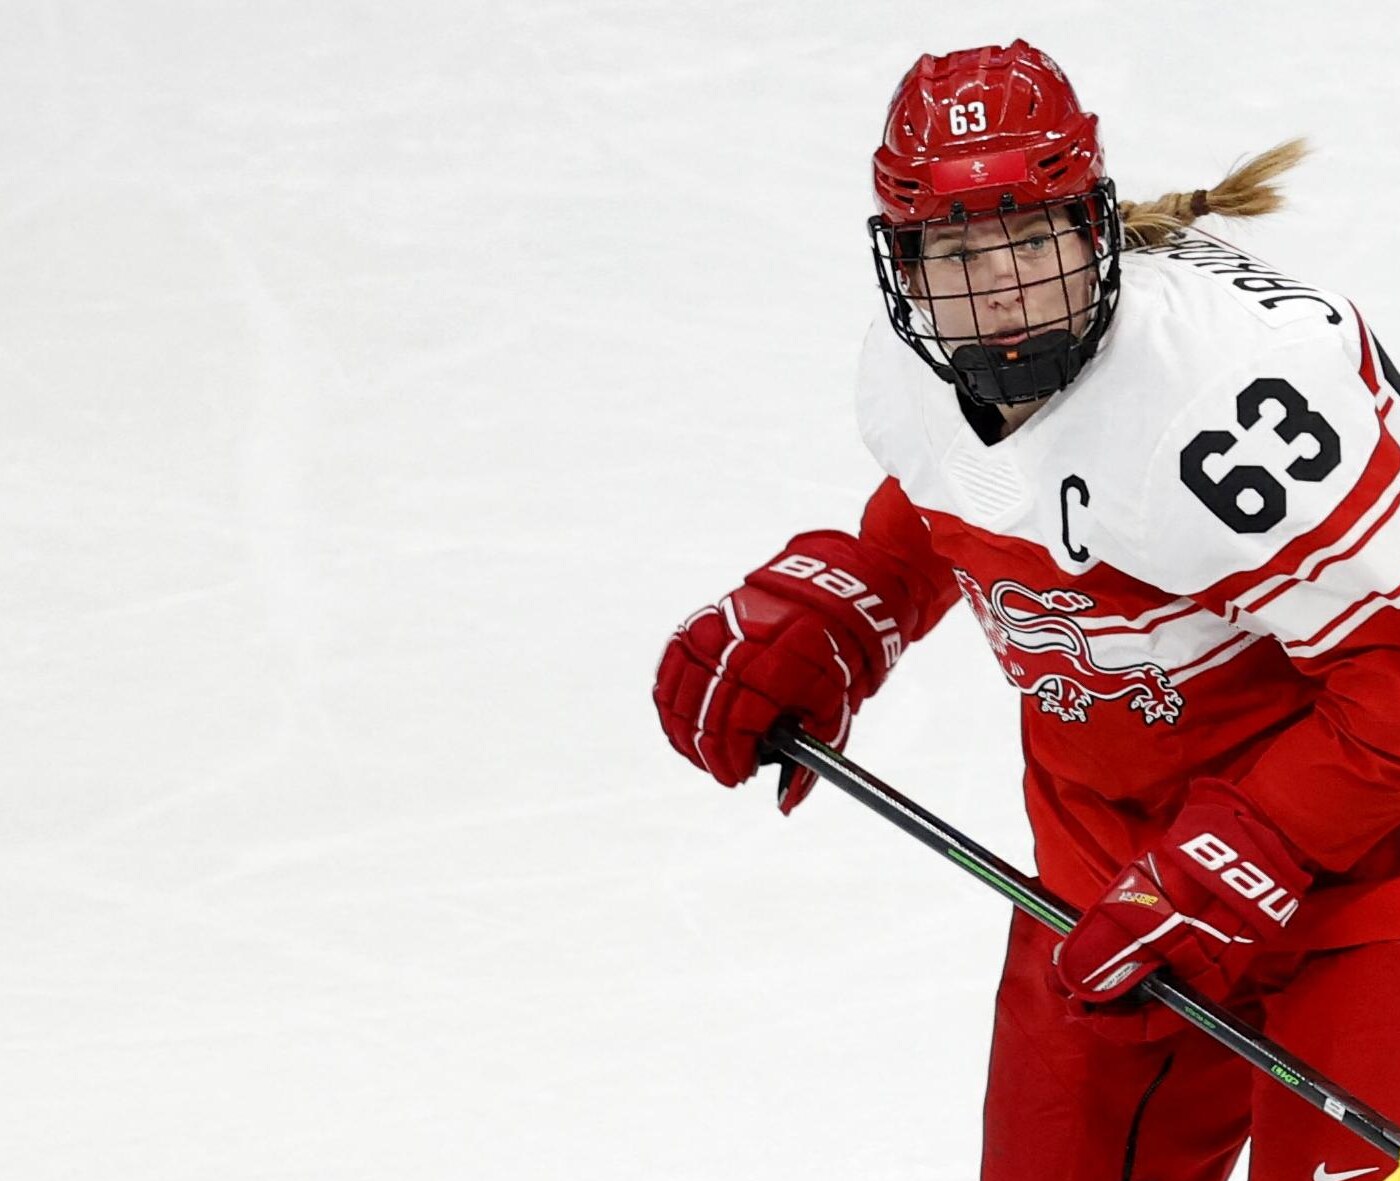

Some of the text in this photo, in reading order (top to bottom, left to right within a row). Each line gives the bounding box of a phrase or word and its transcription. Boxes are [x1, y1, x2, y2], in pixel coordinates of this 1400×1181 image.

[949, 101, 988, 136] 63
[1140, 228, 1343, 325] JAKOB
[1179, 377, 1342, 535] 63
[1060, 473, 1091, 563] C
[768, 554, 902, 669] BAUE
[1178, 831, 1300, 928] BAU
